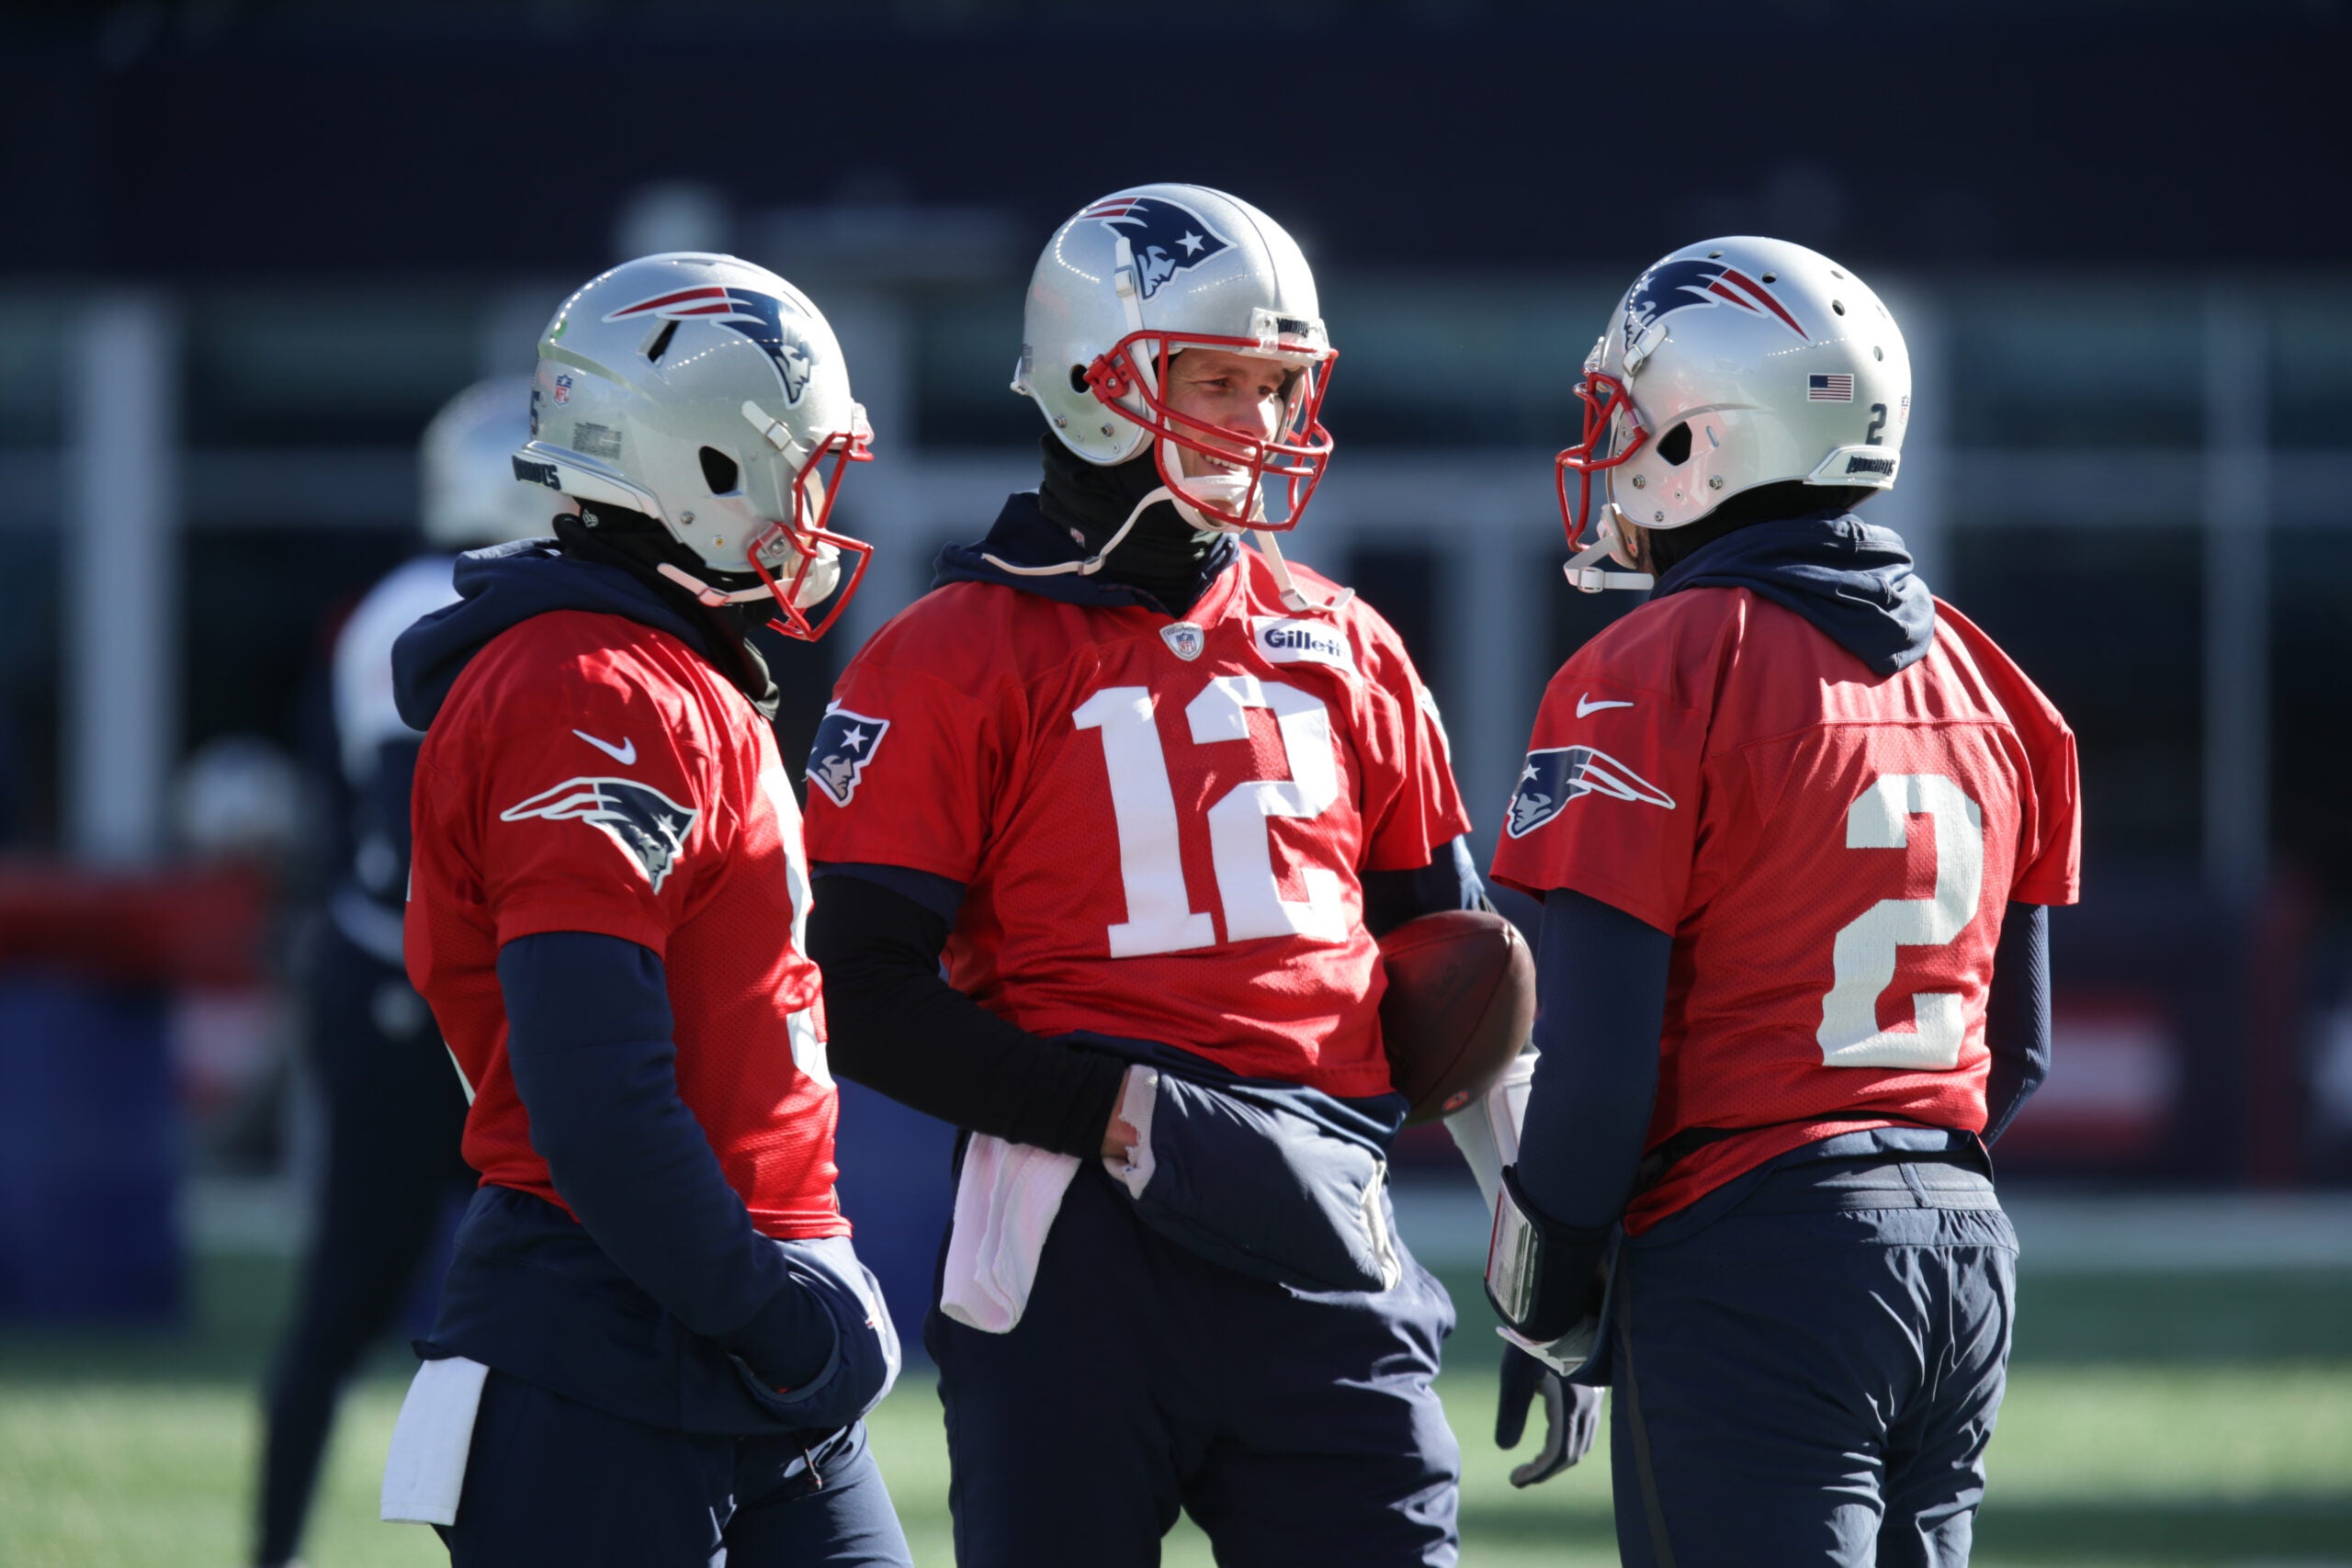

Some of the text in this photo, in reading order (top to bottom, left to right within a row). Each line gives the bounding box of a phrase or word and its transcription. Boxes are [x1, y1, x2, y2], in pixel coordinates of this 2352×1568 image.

[1866, 403, 1887, 446] 2
[1072, 676, 1348, 958] 12
[1816, 774, 1984, 1070] 2
